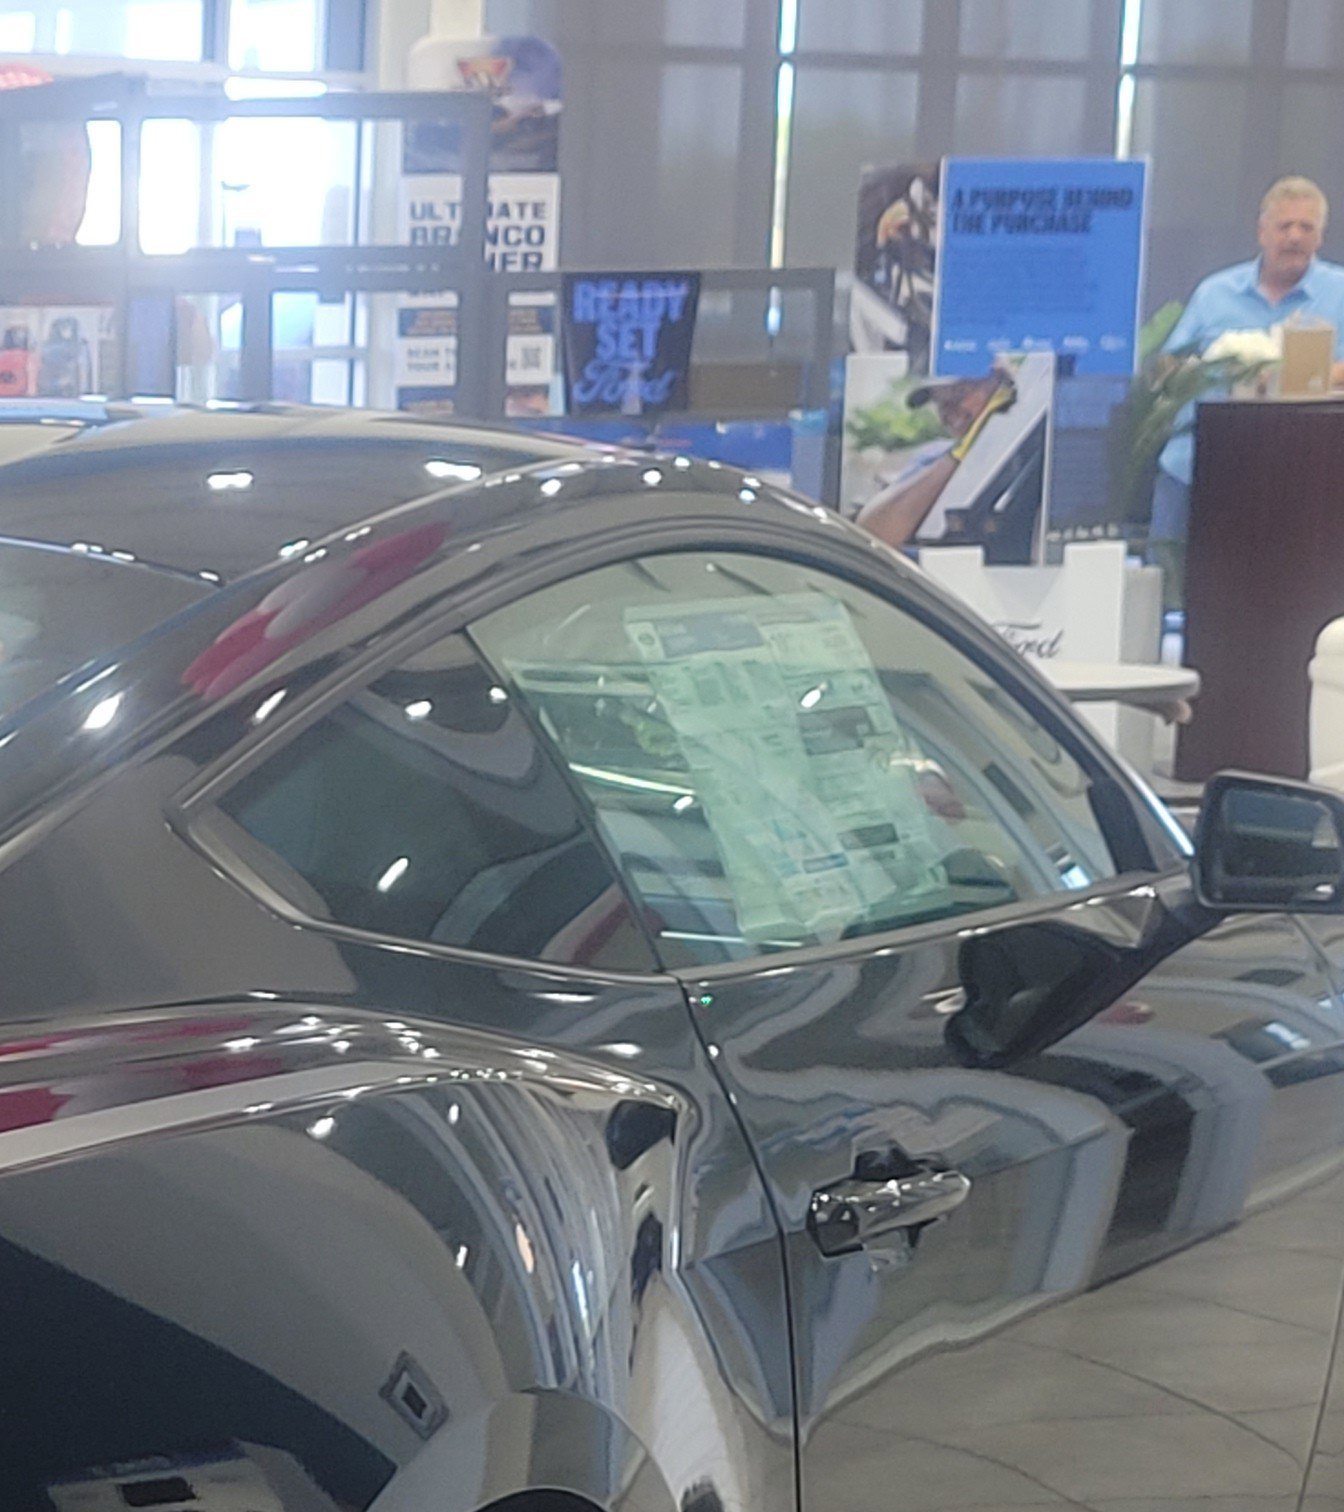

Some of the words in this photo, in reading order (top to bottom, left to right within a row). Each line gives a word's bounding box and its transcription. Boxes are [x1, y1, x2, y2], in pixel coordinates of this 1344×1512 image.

[969, 187, 1056, 208] PURPOSE
[411, 201, 546, 220] ULTATE
[990, 211, 1091, 235] PURCHASE
[411, 224, 546, 247] BRNCO
[573, 281, 688, 322] READY
[595, 319, 657, 360] SET
